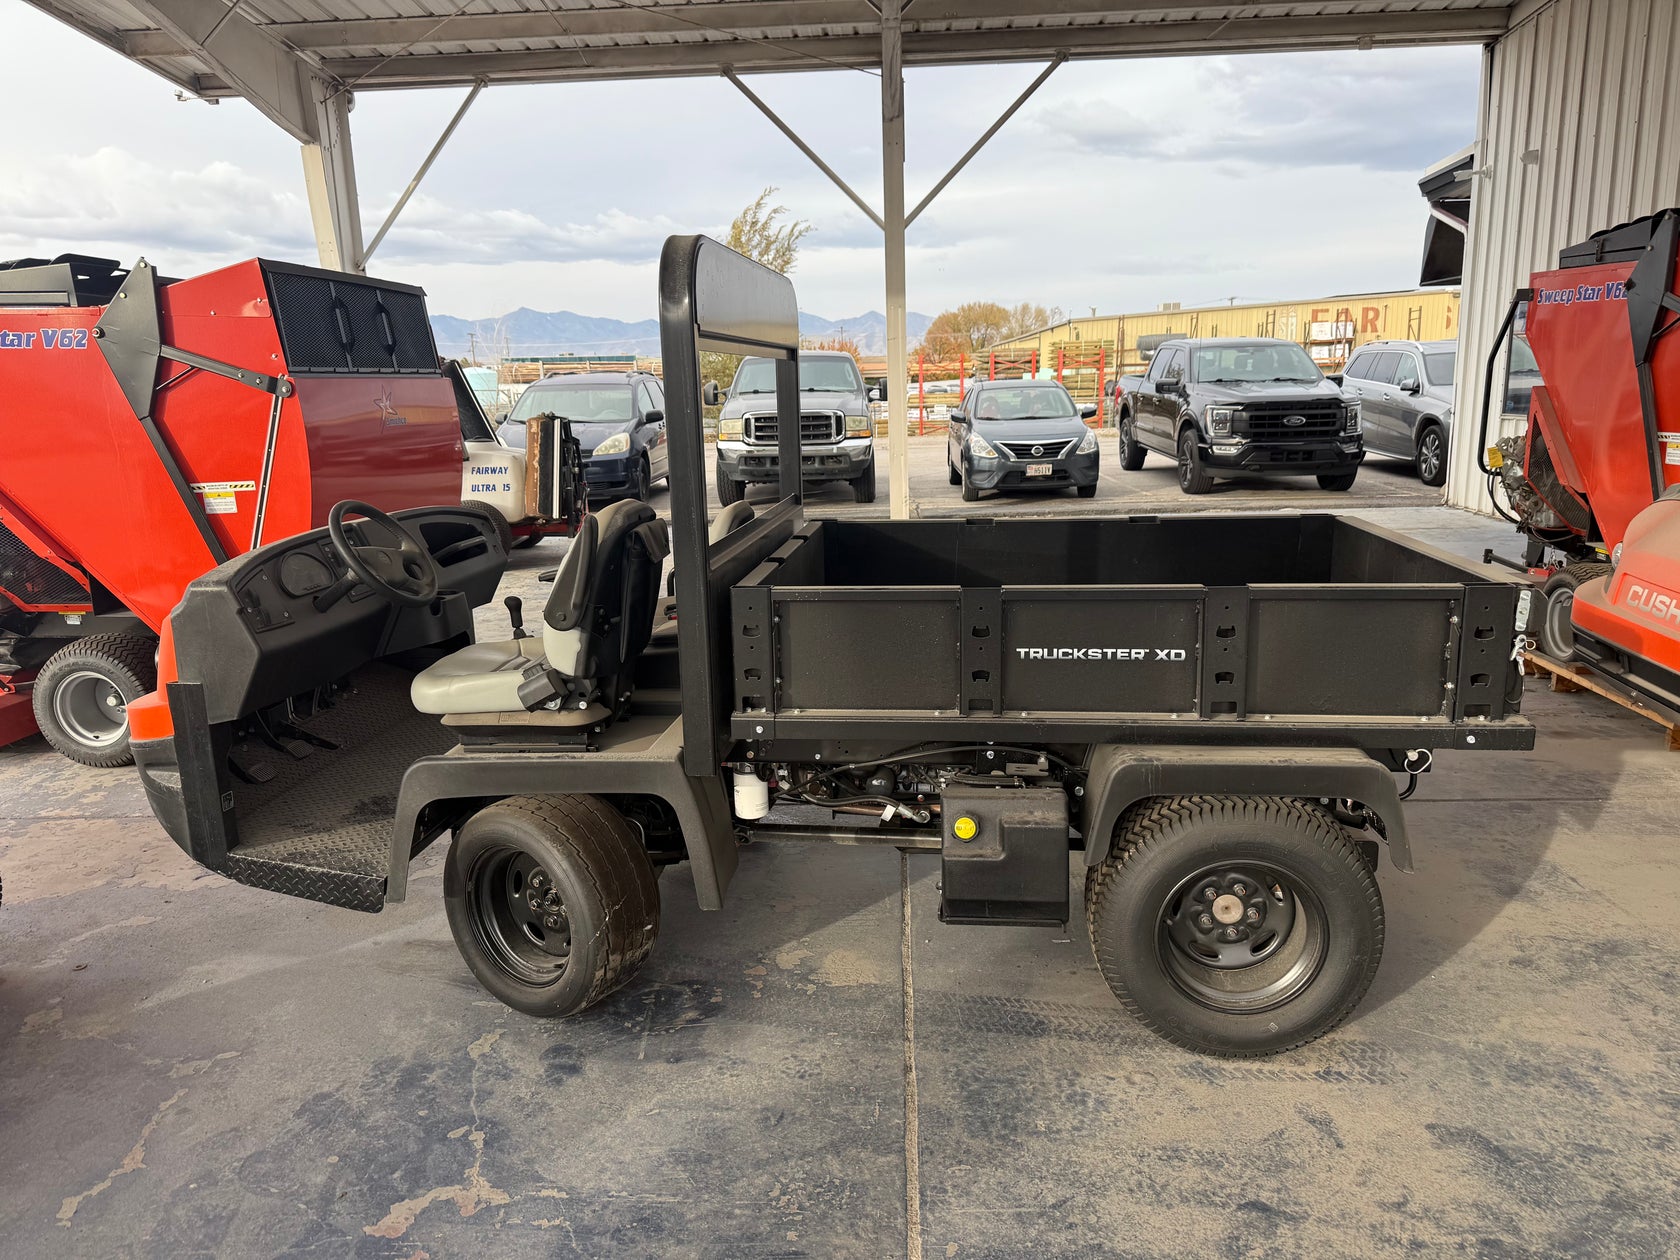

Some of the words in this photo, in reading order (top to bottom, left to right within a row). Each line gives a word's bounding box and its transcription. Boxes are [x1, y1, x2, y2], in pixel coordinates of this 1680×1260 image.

[1537, 287, 1574, 306] Sweep
[1575, 284, 1604, 303] Star
[40, 328, 88, 349] V62
[471, 466, 509, 475] FAIRWAY
[471, 484, 497, 492] ULTRA
[502, 483, 511, 492] 15
[1627, 585, 1680, 625] CUSH
[1154, 649, 1187, 661] XD
